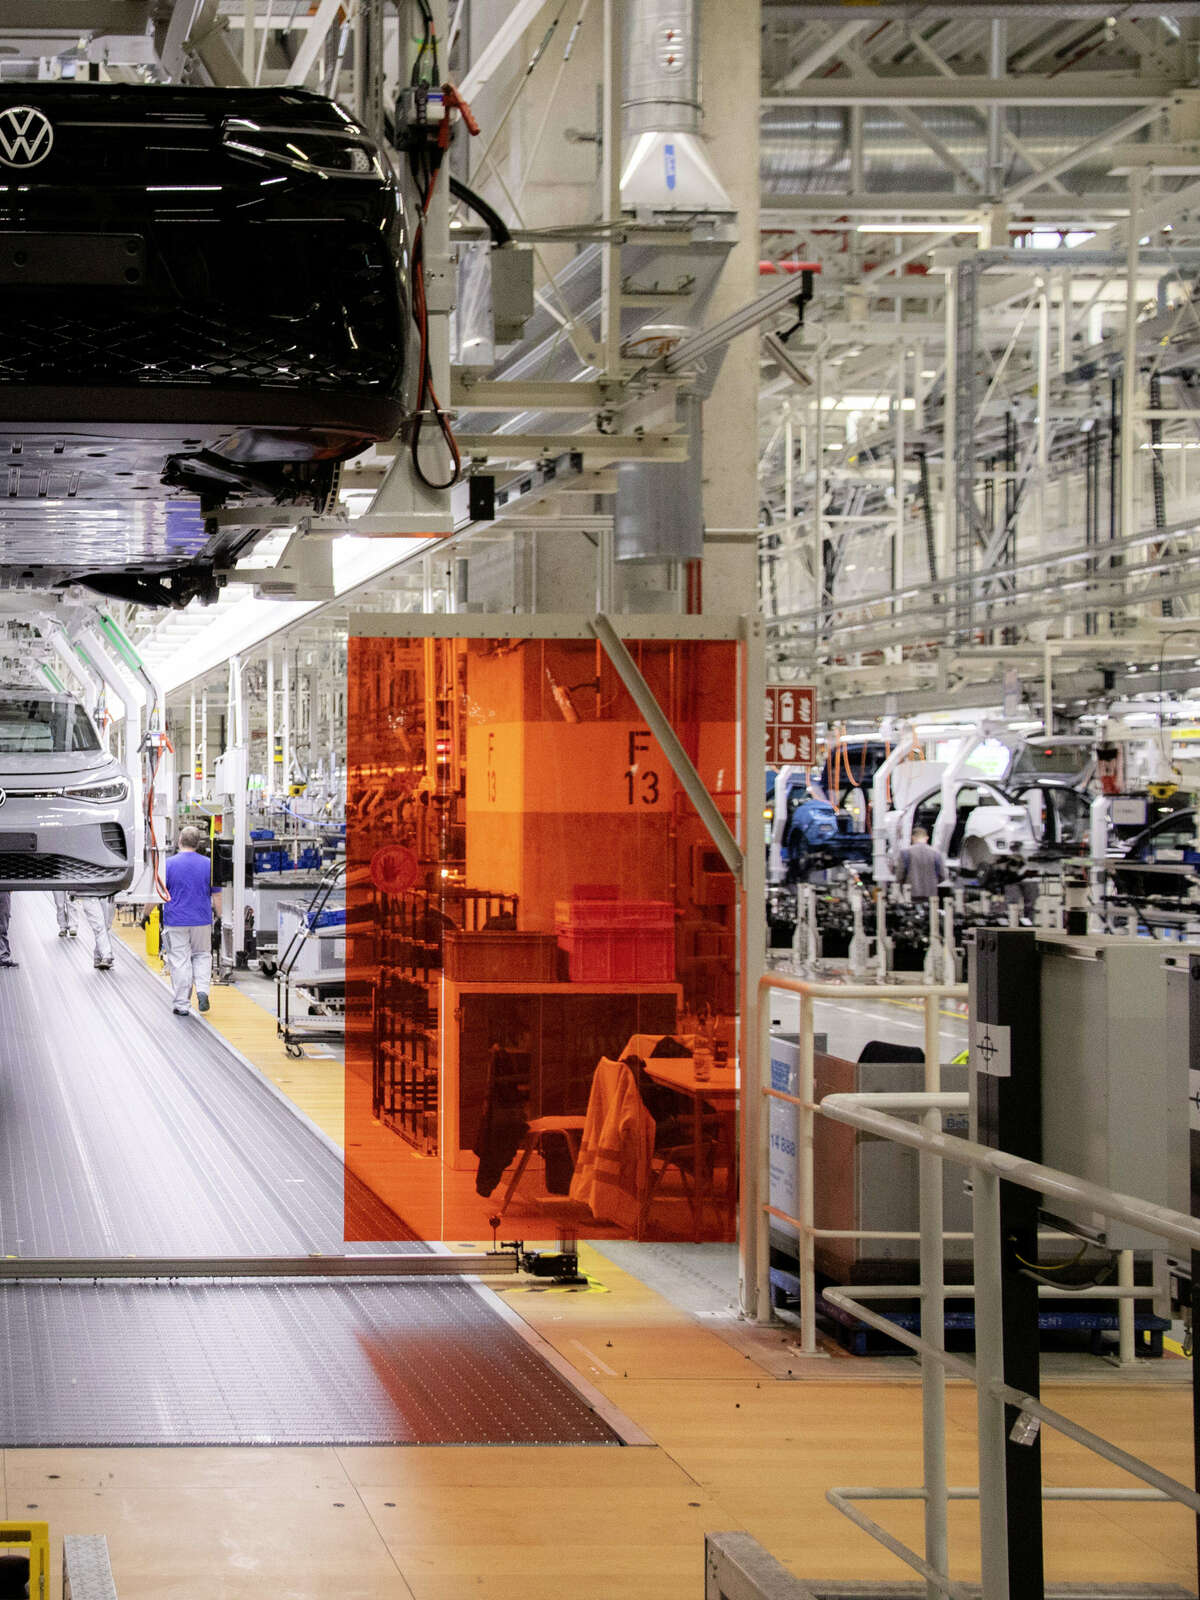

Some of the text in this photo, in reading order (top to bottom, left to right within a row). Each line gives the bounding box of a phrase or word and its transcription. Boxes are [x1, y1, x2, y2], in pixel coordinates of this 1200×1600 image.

[629, 731, 651, 765] F
[487, 770, 496, 803] 13
[624, 771, 659, 805] 13
